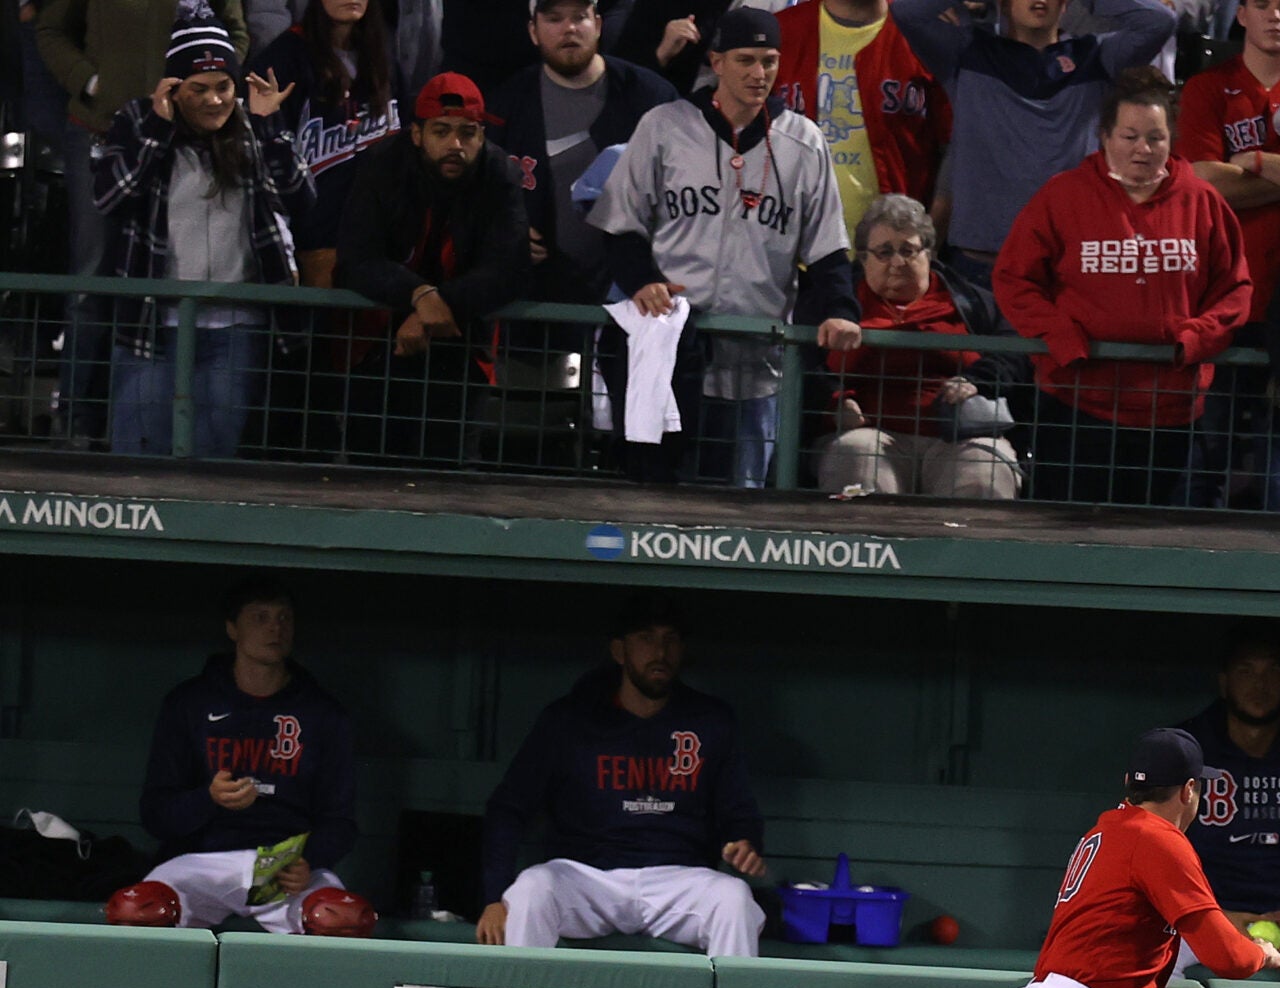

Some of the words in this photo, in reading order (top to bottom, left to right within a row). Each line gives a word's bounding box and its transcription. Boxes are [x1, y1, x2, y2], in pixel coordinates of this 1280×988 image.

[881, 78, 928, 118] SO
[829, 150, 862, 166] ox
[664, 185, 794, 236] BOSTON
[1080, 238, 1198, 256] BOSTON
[1080, 256, 1138, 273] RED
[1143, 254, 1198, 273] SOX
[22, 498, 165, 531] MINOLTA
[630, 531, 756, 563] KONICA
[761, 538, 902, 569] MINOLTA
[271, 715, 302, 760] B
[669, 731, 702, 776] B
[1243, 791, 1269, 804] RED
